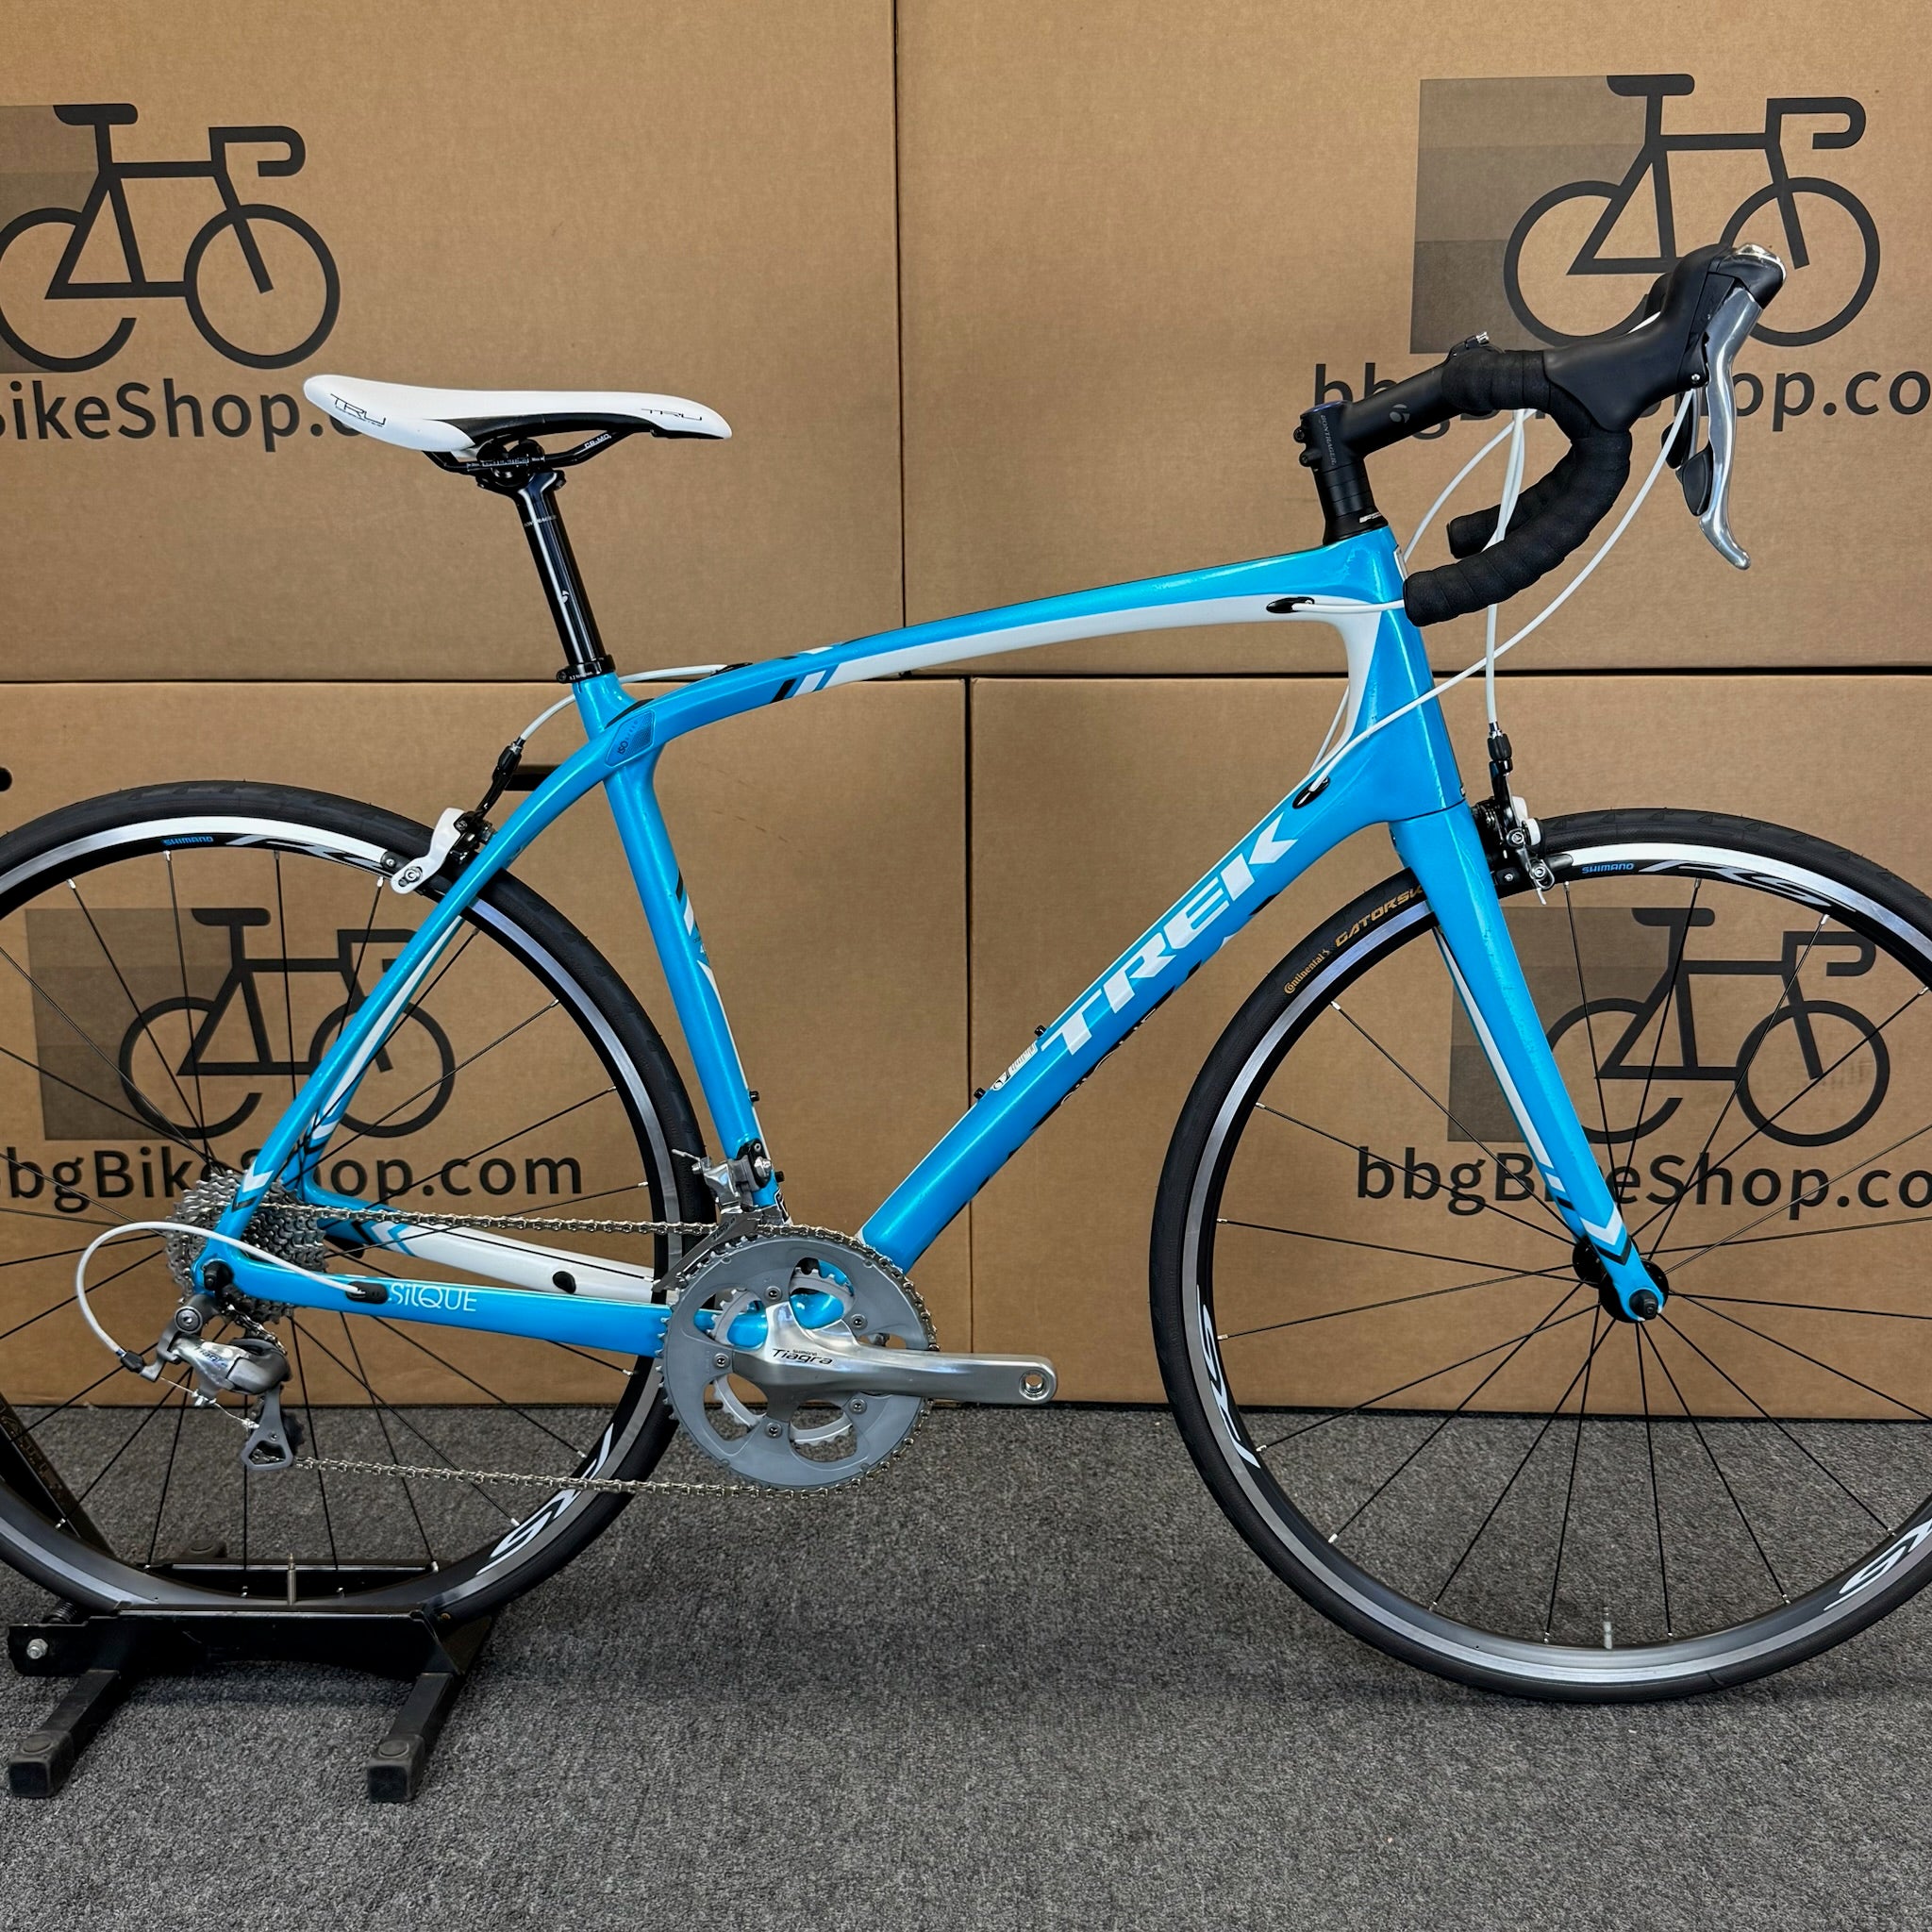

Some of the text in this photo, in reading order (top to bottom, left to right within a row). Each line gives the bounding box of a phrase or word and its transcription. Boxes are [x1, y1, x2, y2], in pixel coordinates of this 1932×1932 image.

[0, 378, 362, 453] ikeShop.
[162, 836, 214, 846] SHIMANO
[1581, 861, 1636, 874] SHIMANO
[1041, 811, 1299, 1056] TREK
[1283, 953, 1325, 994] Continental
[1357, 1147, 1932, 1221] bbgBeShop.co
[772, 1348, 833, 1366] Tiagra
